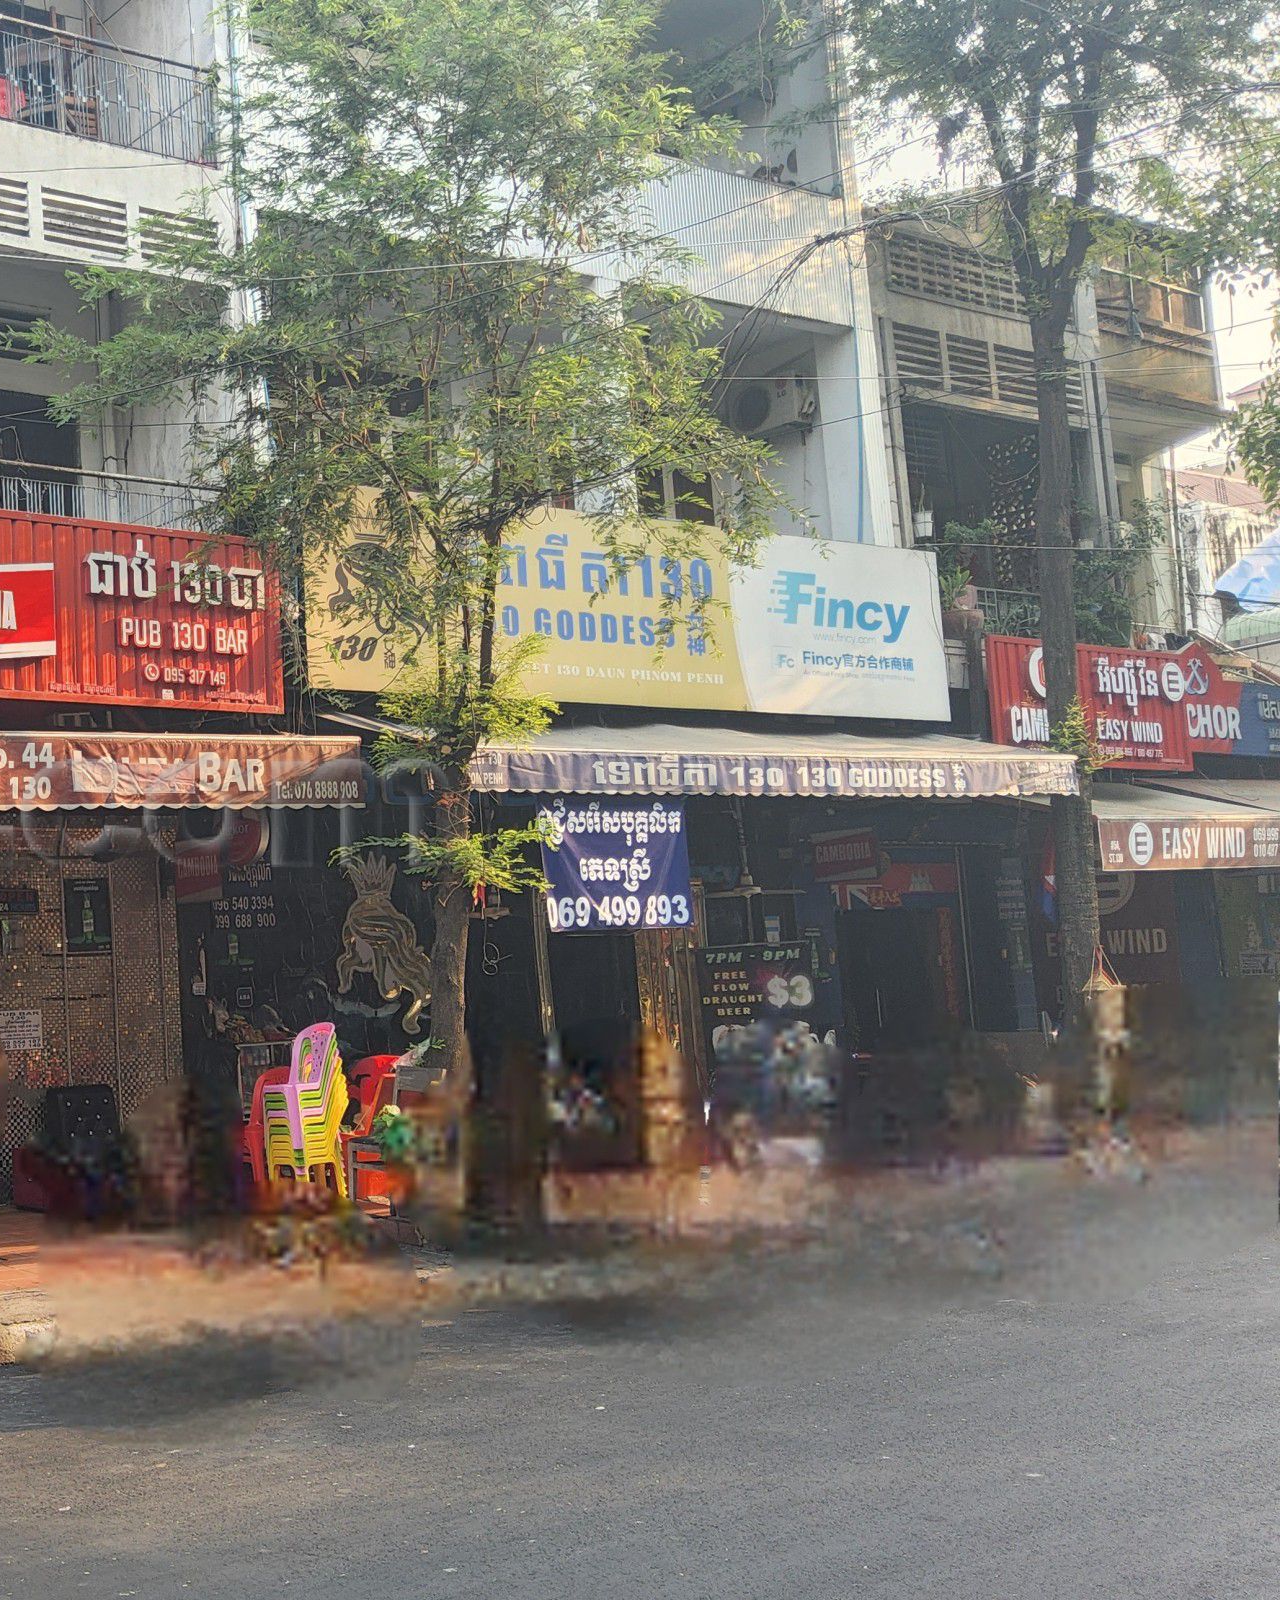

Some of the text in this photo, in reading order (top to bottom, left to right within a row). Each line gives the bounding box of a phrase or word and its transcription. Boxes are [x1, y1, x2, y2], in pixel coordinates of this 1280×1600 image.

[771, 570, 911, 644] Fincy
[120, 617, 249, 655] PUB 130 BAR
[163, 667, 226, 686] 095 317 149
[557, 664, 581, 677] 130
[586, 667, 625, 680] DAUN
[631, 670, 683, 684] PHNOM
[687, 672, 725, 685] PENH
[1096, 718, 1163, 744] EASY WIND
[21, 742, 56, 769] 44
[198, 751, 266, 792] BAR
[483, 772, 504, 785] PENH
[728, 766, 785, 787] 130
[796, 766, 842, 788] 130
[848, 767, 946, 788] GODDESS
[9, 776, 52, 800] 130
[294, 781, 313, 800] 076
[314, 781, 338, 800] 8888
[339, 781, 358, 800] 908
[815, 841, 872, 865] CAMBODIA
[1162, 826, 1246, 860] EASY WIND
[232, 896, 249, 911] 540
[251, 895, 274, 910] 3394
[546, 894, 690, 929] 069 499 893
[235, 913, 252, 928] 688
[257, 912, 276, 927] 900
[1106, 927, 1168, 955] WIND
[705, 952, 742, 964] 7PM
[762, 948, 800, 961] 9PM
[714, 971, 748, 980] FREE
[713, 983, 750, 992] FLOW
[767, 975, 812, 1009] $3
[702, 994, 764, 1005] DRAUGHT
[717, 1007, 752, 1016] BEER
